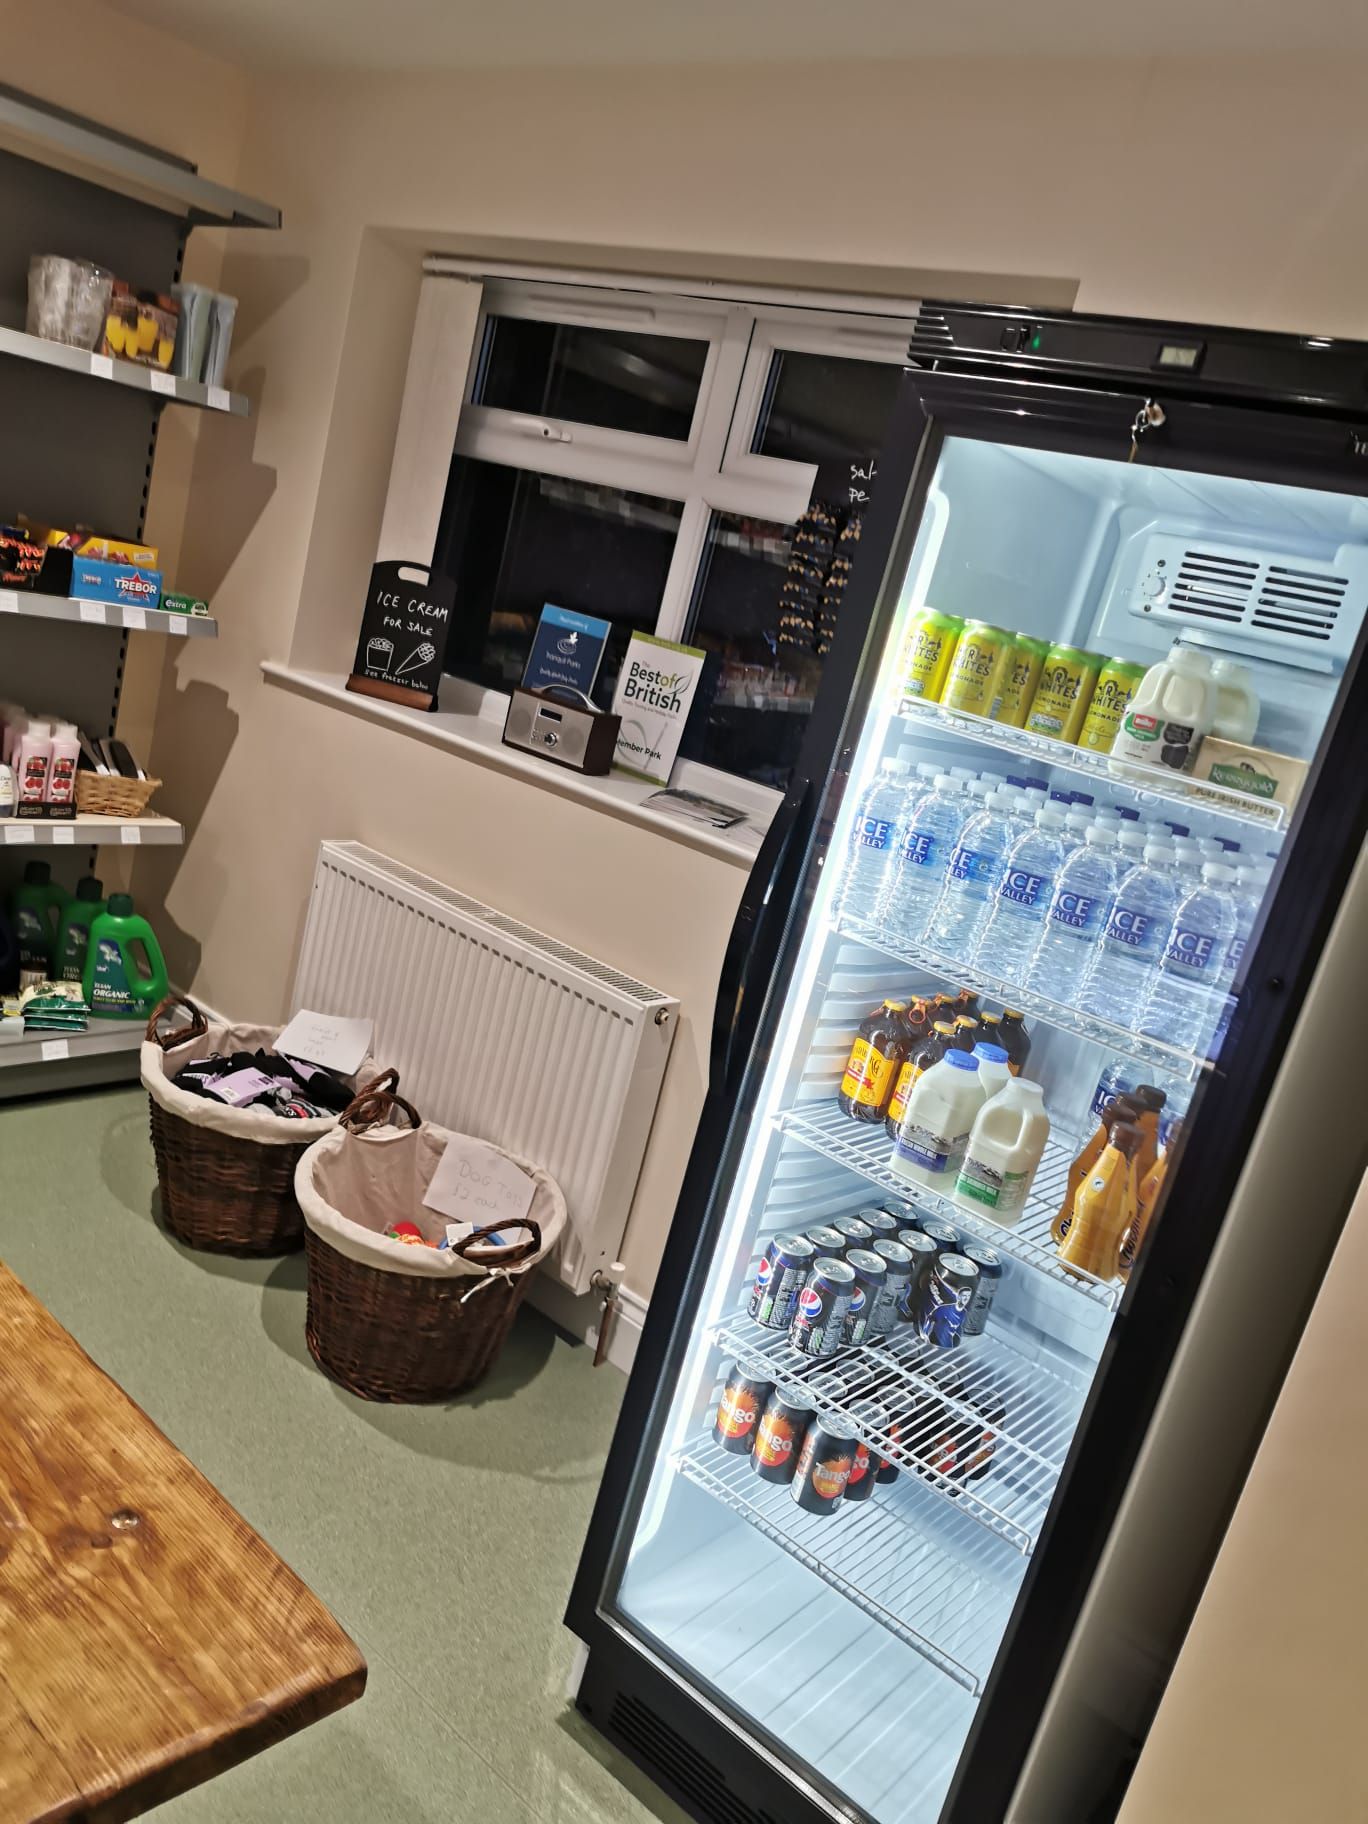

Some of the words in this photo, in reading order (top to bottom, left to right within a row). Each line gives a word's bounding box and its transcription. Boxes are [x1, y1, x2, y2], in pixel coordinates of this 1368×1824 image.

[114, 578, 157, 595] TREBOR
[165, 599, 187, 610] extra
[376, 591, 401, 608] ICE
[407, 599, 449, 624] CREAM
[383, 615, 402, 630] FOR
[407, 621, 433, 637] SALE
[624, 678, 681, 713] British
[645, 746, 662, 761] Park
[856, 815, 888, 839] ICE
[950, 847, 973, 870] CE
[1001, 868, 1041, 895] ICE
[999, 887, 1036, 906] VALLEY
[1051, 892, 1091, 918] ICE
[1107, 905, 1149, 935] ICE
[1168, 928, 1213, 957] ICE
[93, 989, 131, 999] ORGANIC
[815, 1462, 850, 1484] Tango
